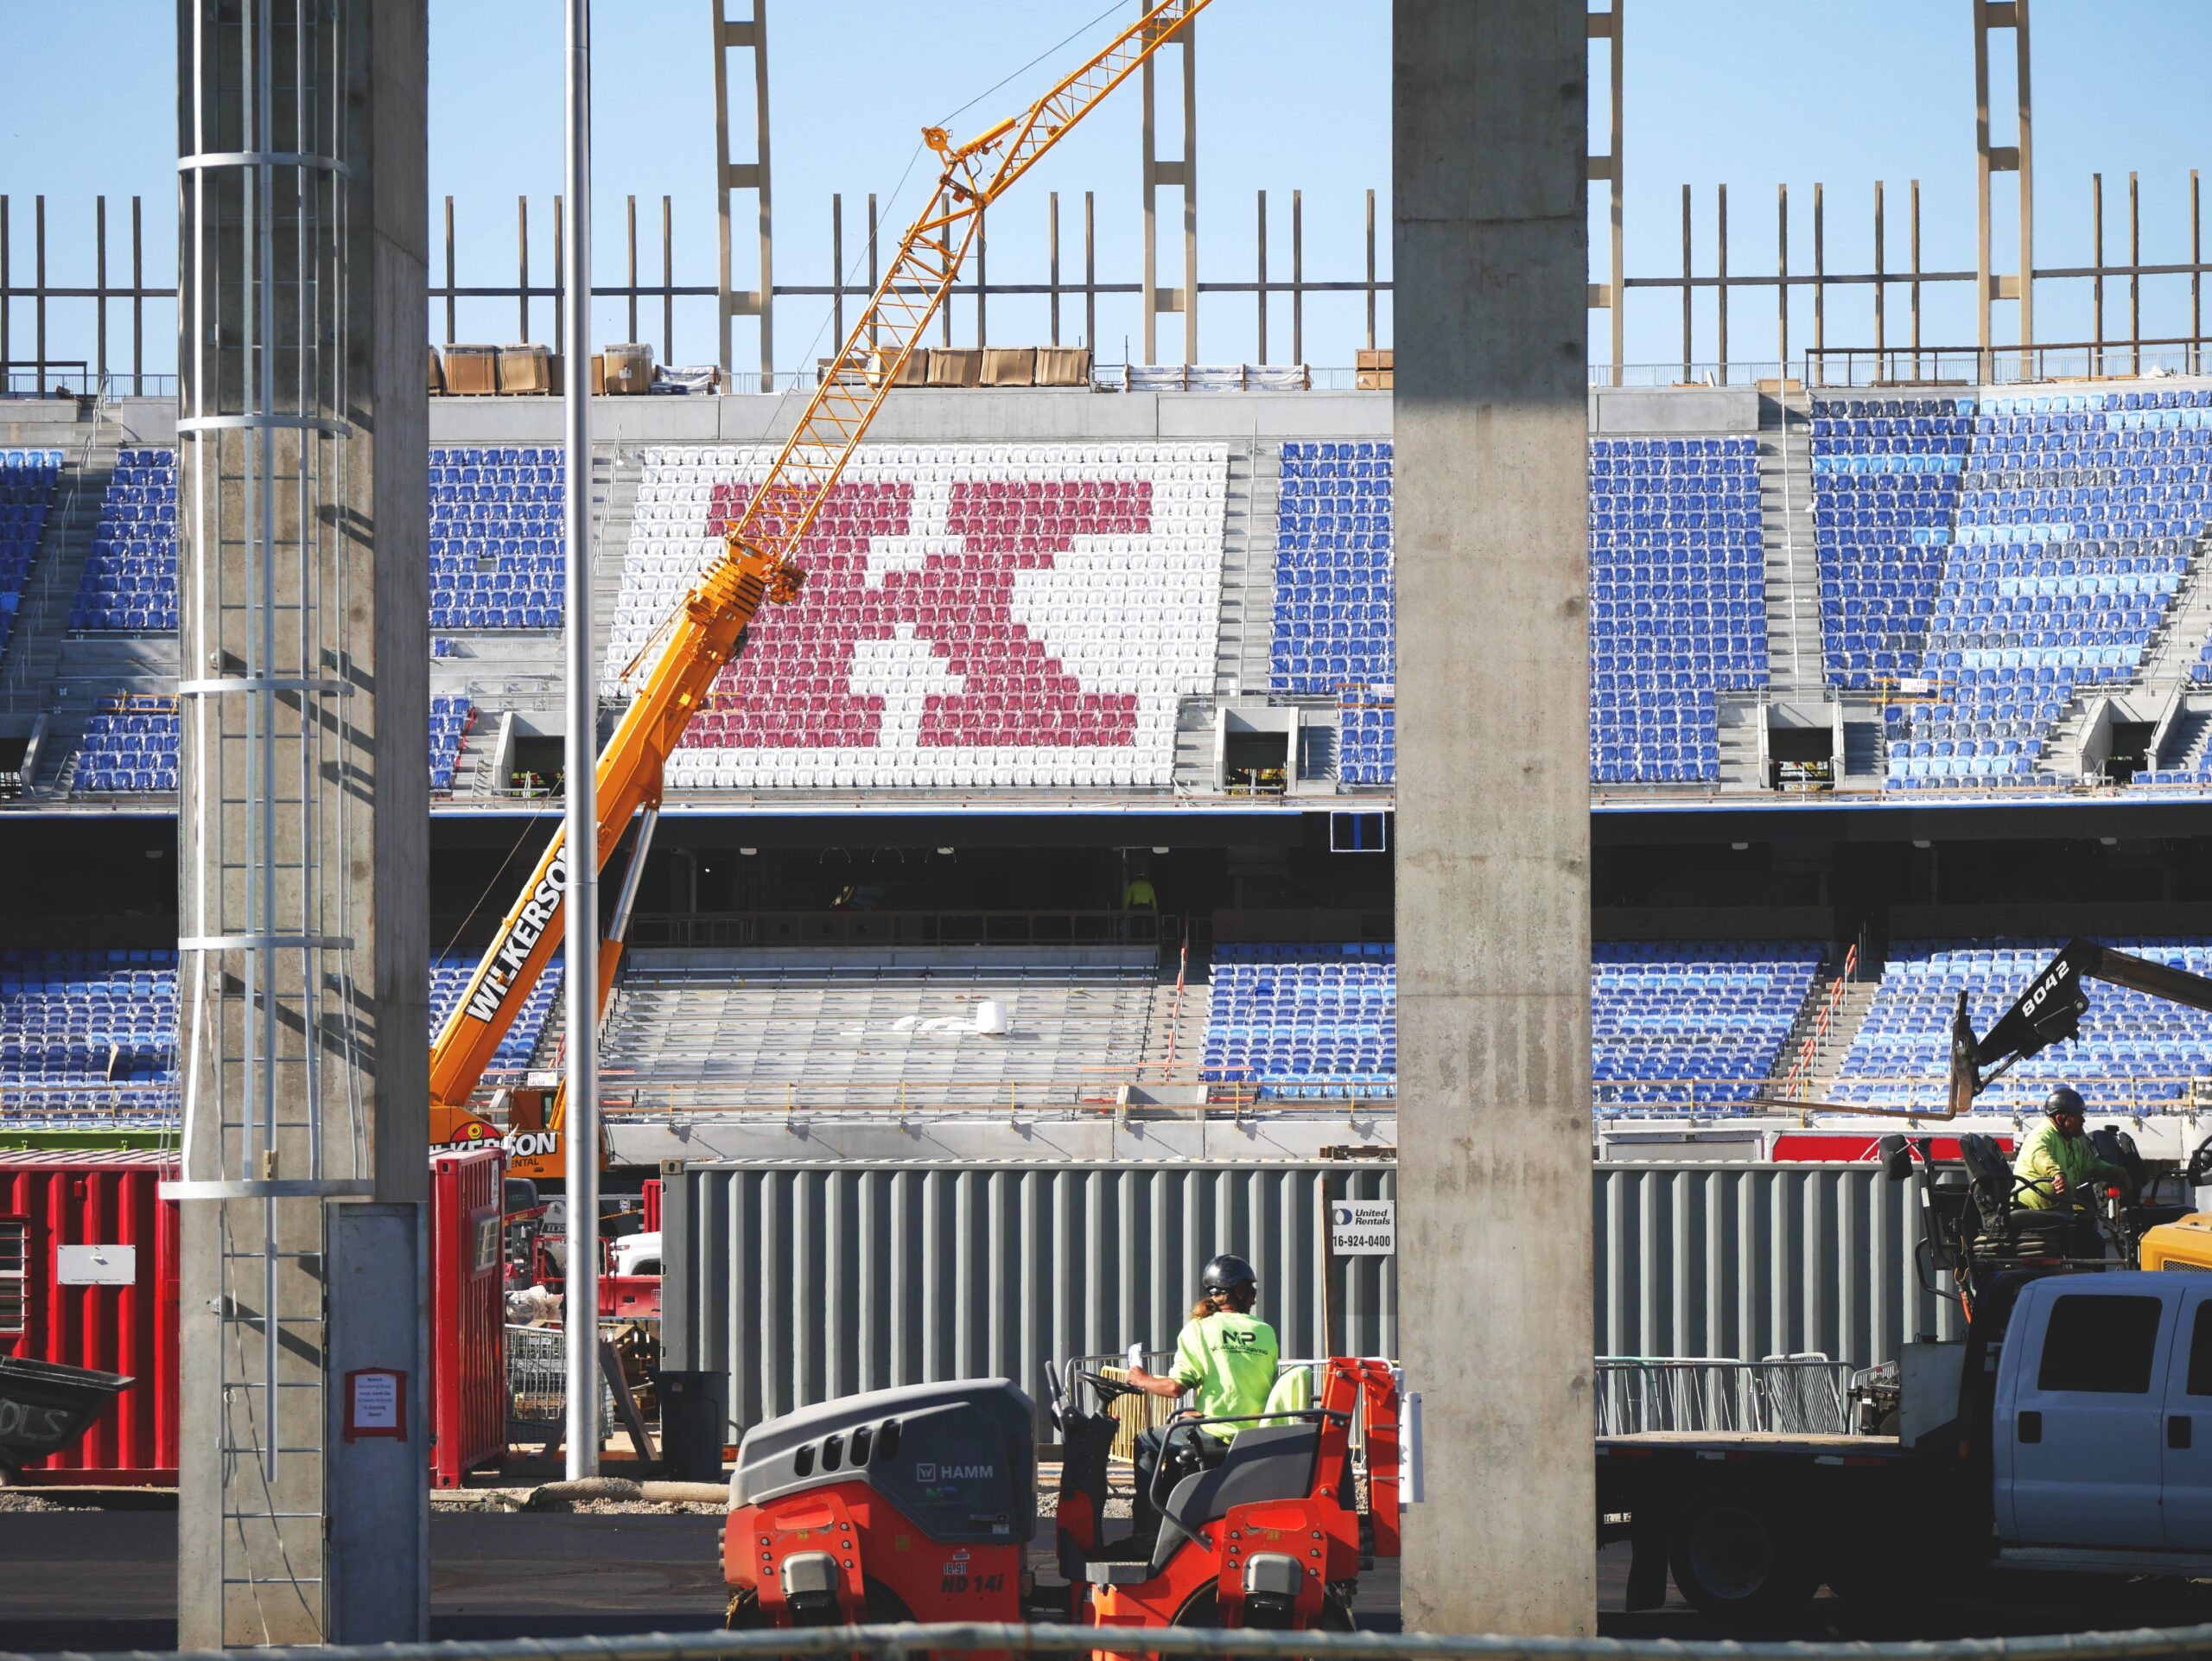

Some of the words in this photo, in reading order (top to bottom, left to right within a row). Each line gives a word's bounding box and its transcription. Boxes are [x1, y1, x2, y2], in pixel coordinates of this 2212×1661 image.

[466, 846, 566, 1022] WILKERSO
[2022, 960, 2070, 1017] 8042
[511, 1158, 539, 1168] ENTAL
[1355, 1217, 1390, 1225] Rentals
[1332, 1235, 1390, 1247] 16-924-0400
[941, 1465, 993, 1479] HAMM
[941, 1575, 969, 1593] HD
[975, 1573, 1004, 1592] 14i
